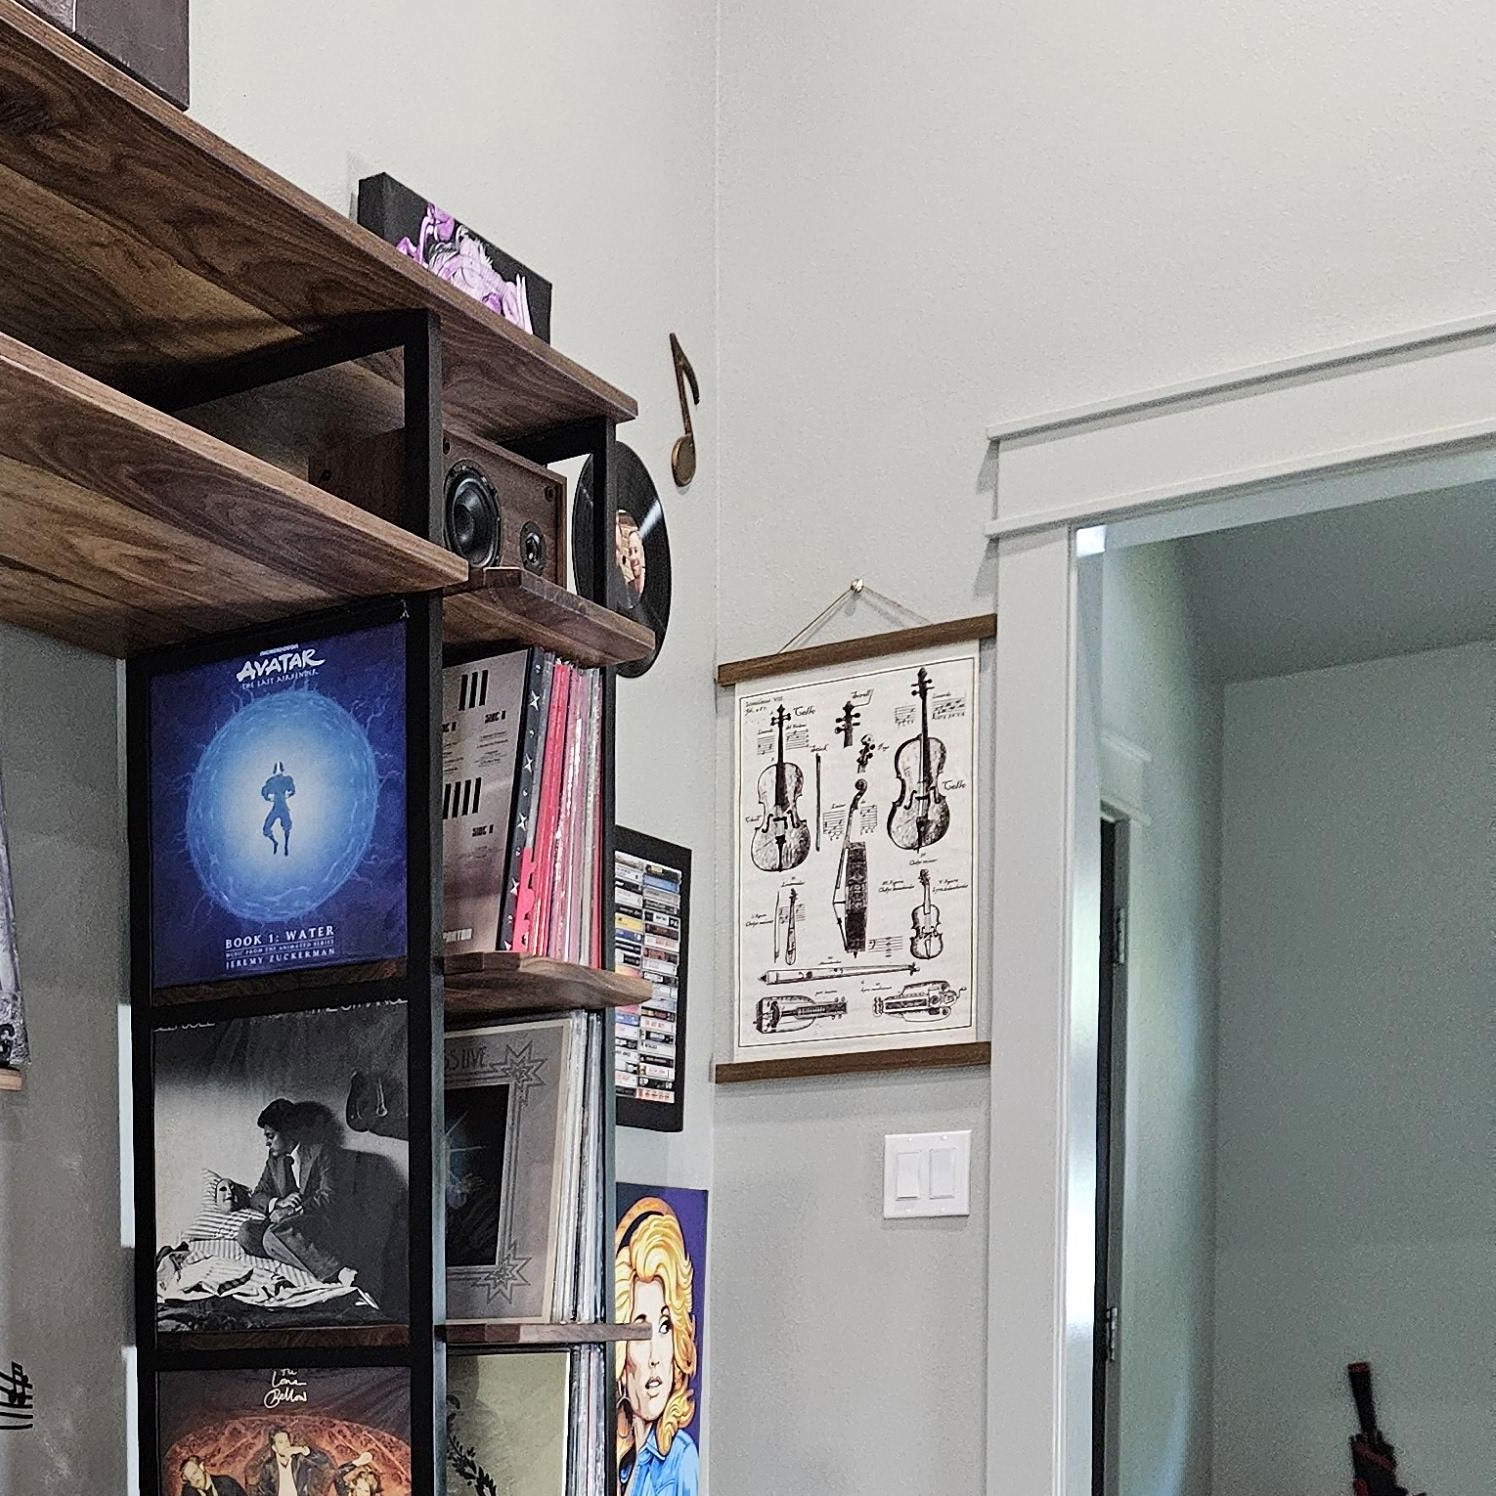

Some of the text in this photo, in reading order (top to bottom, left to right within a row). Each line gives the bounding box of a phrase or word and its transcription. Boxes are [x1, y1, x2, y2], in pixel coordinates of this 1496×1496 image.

[236, 649, 326, 682] AVATAR
[225, 935, 262, 949] BOOK
[286, 925, 334, 940] WATER
[226, 948, 335, 970] JEREMY ZUCKERMAN
